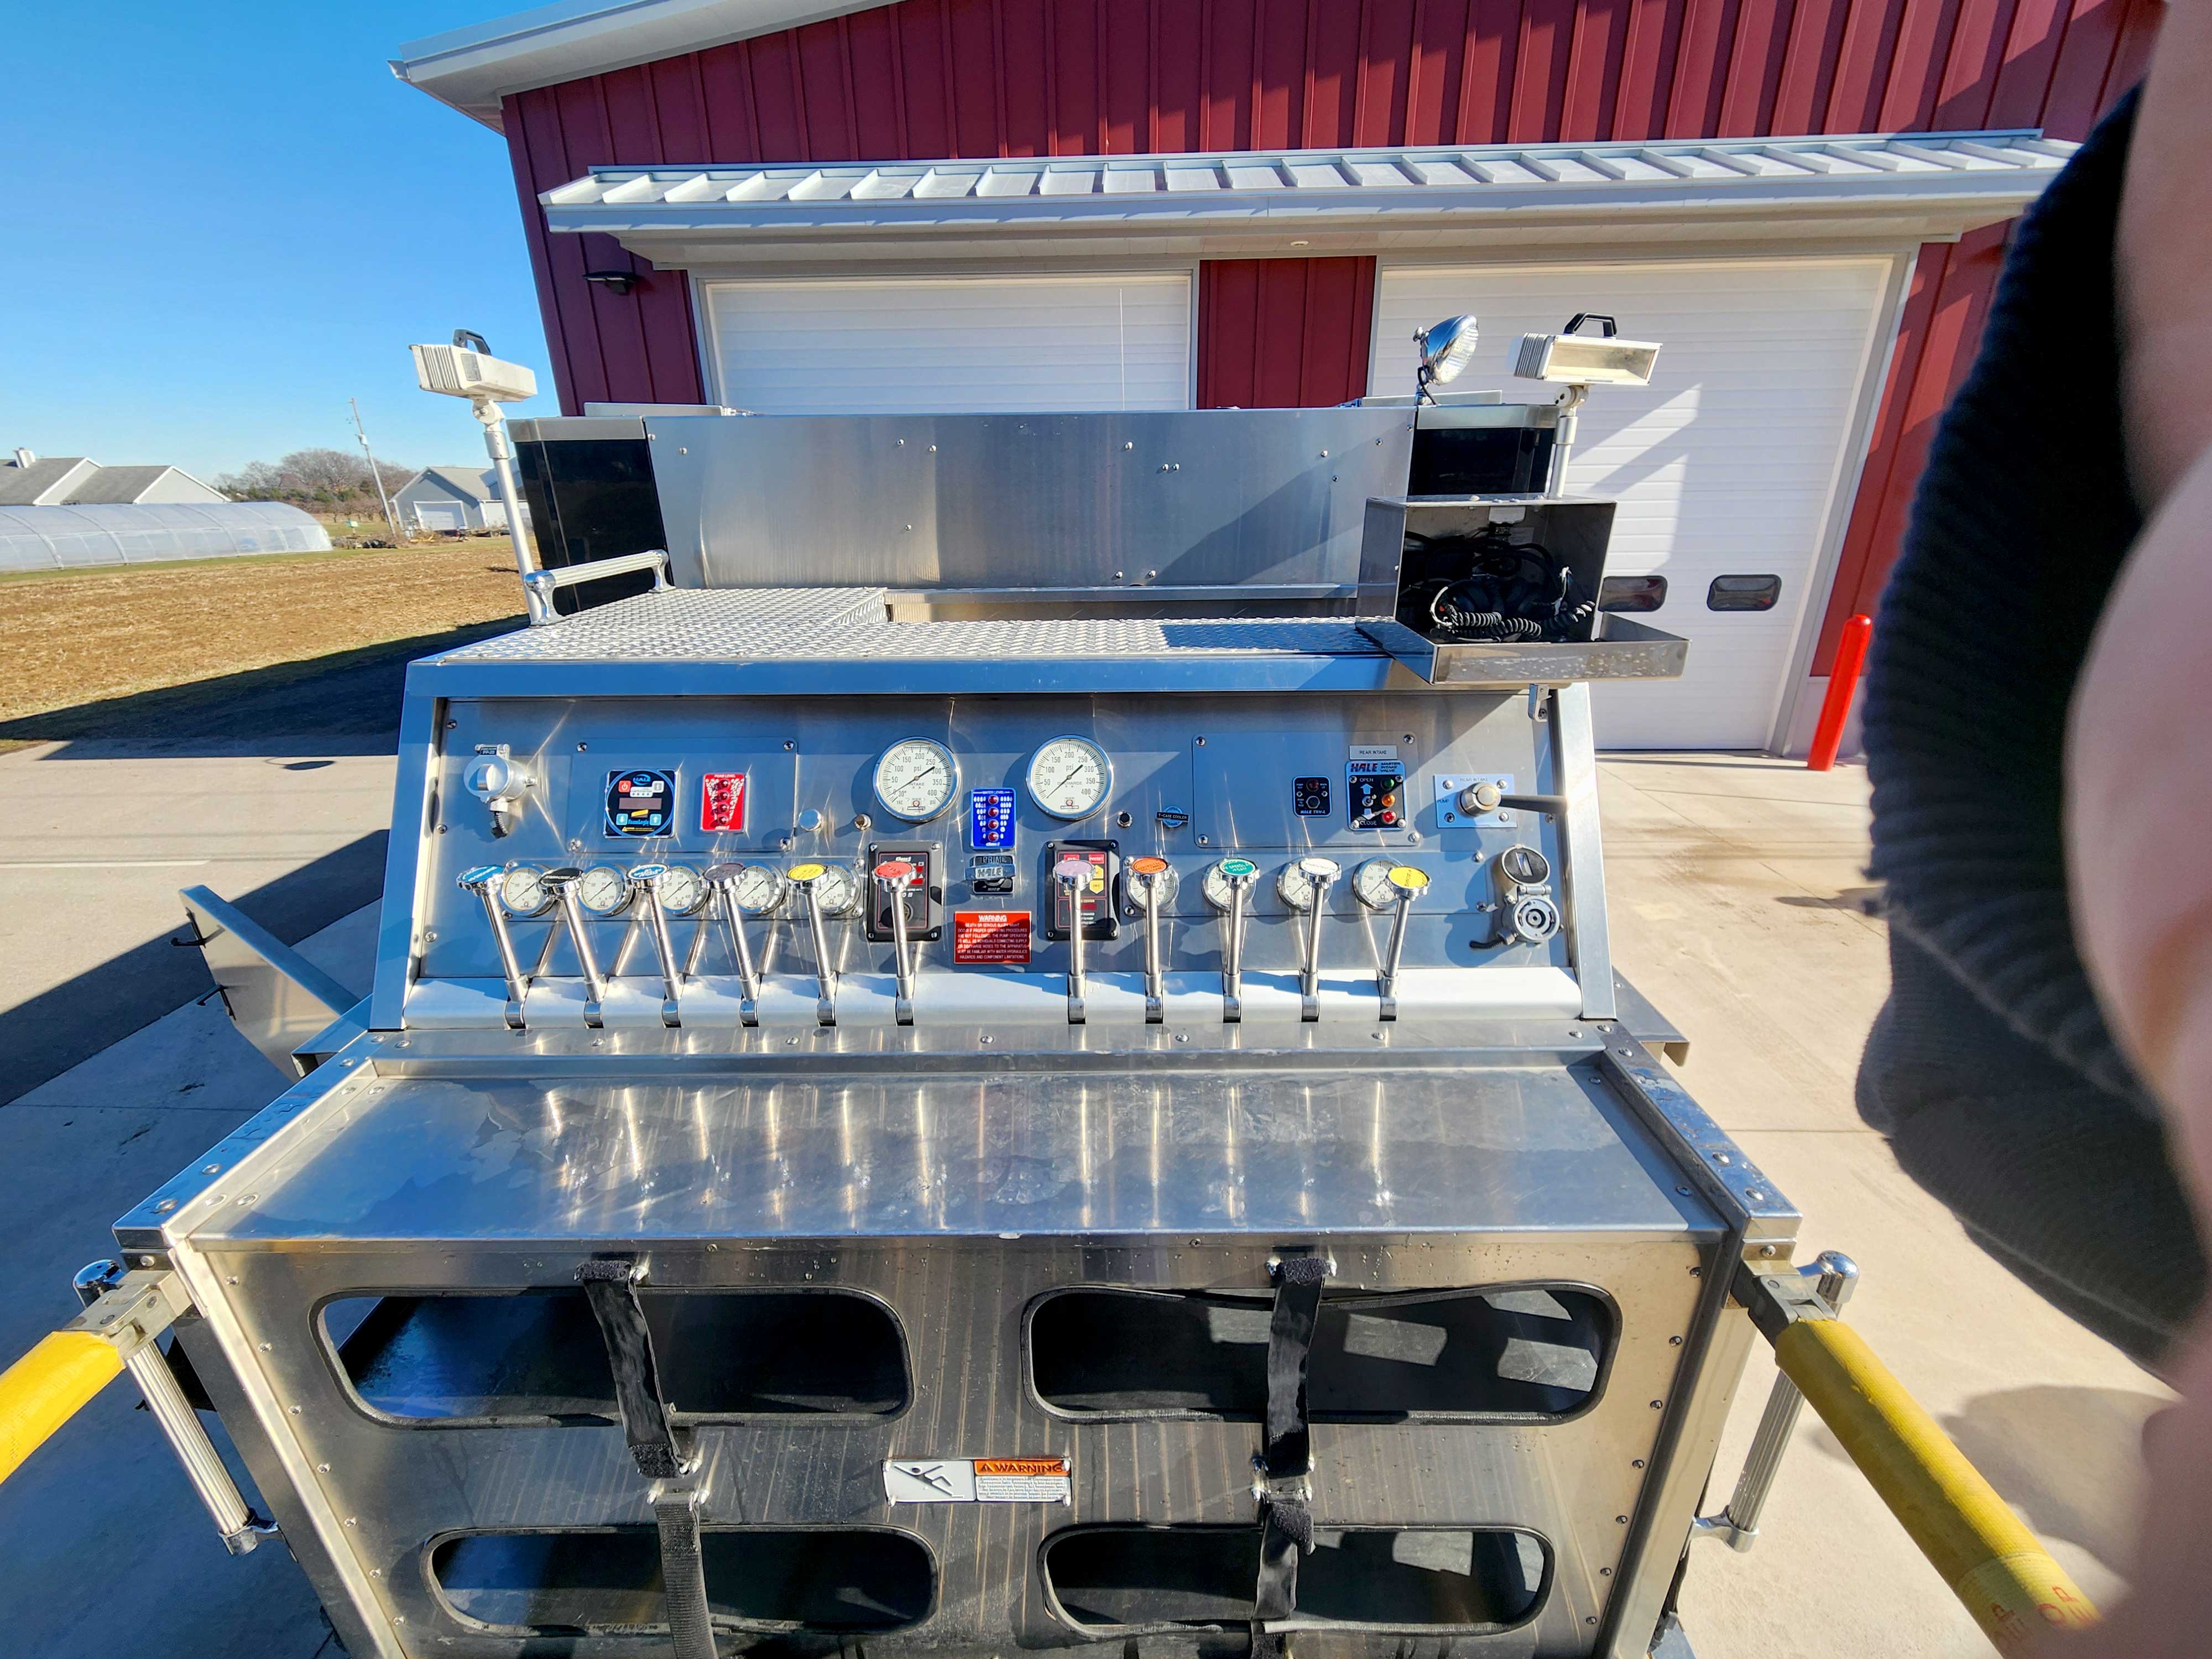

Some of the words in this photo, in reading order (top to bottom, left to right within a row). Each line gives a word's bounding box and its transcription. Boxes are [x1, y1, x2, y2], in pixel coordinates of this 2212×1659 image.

[1350, 763, 1379, 773] HALE
[977, 867, 1003, 878] HALE
[995, 1463, 1063, 1473] WARNING
